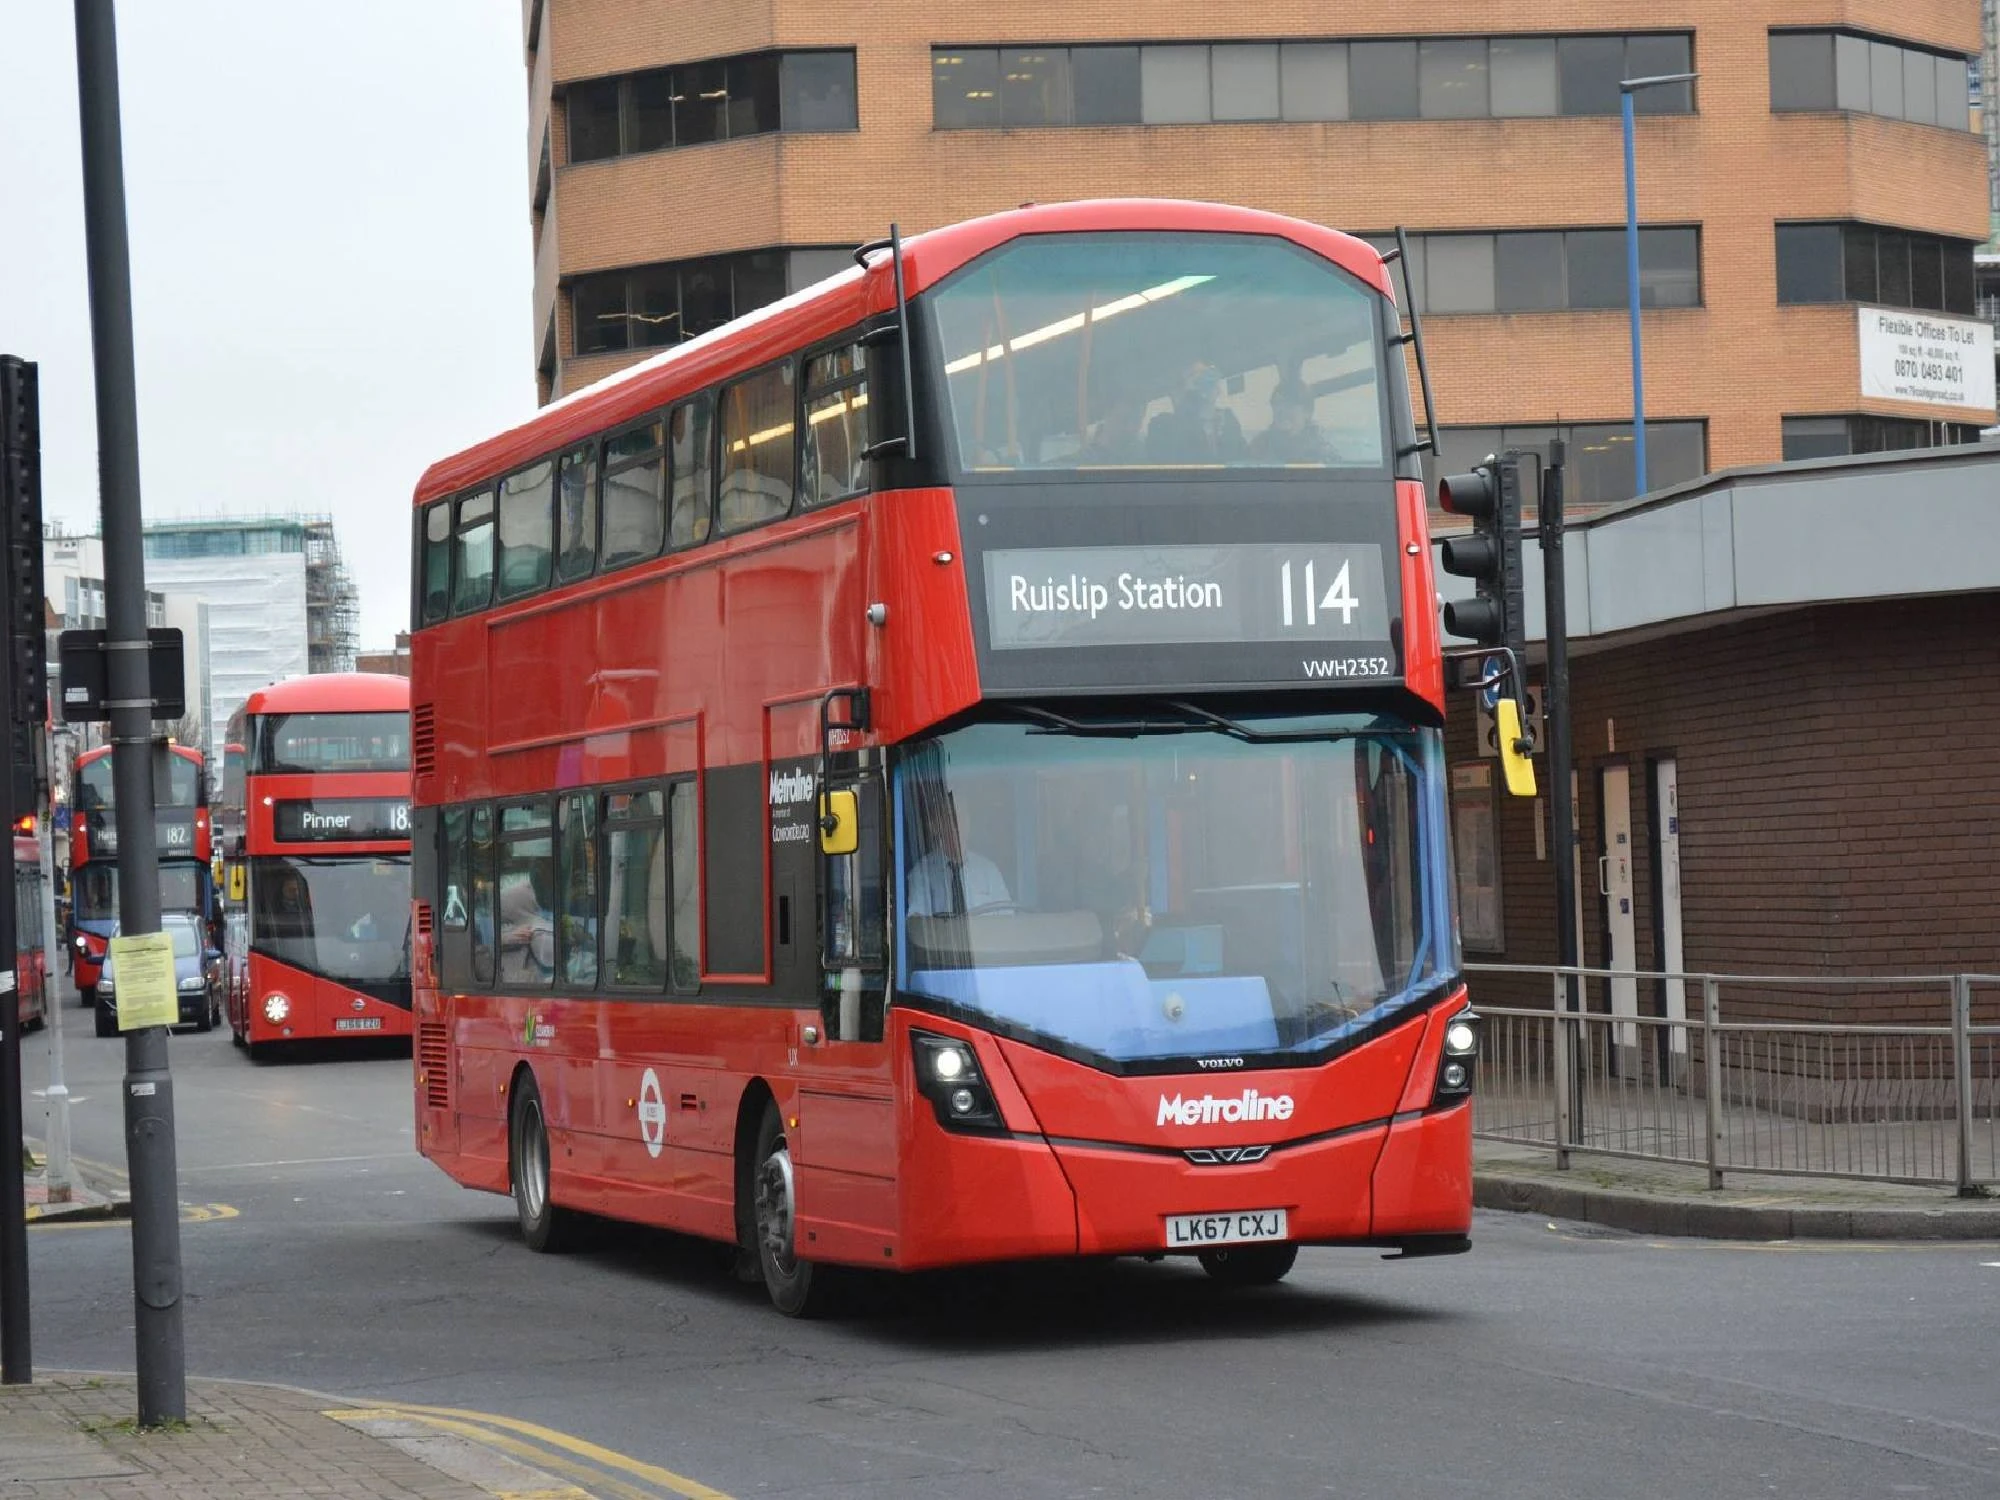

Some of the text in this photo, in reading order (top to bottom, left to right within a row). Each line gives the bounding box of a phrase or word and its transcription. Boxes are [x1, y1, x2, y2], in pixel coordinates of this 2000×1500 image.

[1879, 316, 1975, 345] Flexible Offices To Let
[1895, 359, 1918, 378] 0870
[1945, 365, 1963, 384] 401
[1010, 572, 1223, 619] Ruislip Station
[1281, 558, 1360, 626] 114
[1303, 657, 1389, 678] VWH2352
[769, 766, 813, 804] Metroline
[303, 811, 352, 829] Pinner
[390, 805, 412, 831] 18
[167, 828, 186, 844] 182
[788, 1047, 799, 1067] UX
[1197, 1057, 1244, 1069] VOLVO
[1156, 1088, 1295, 1127] Metroline
[1175, 1213, 1279, 1242] LK67 CXJ
